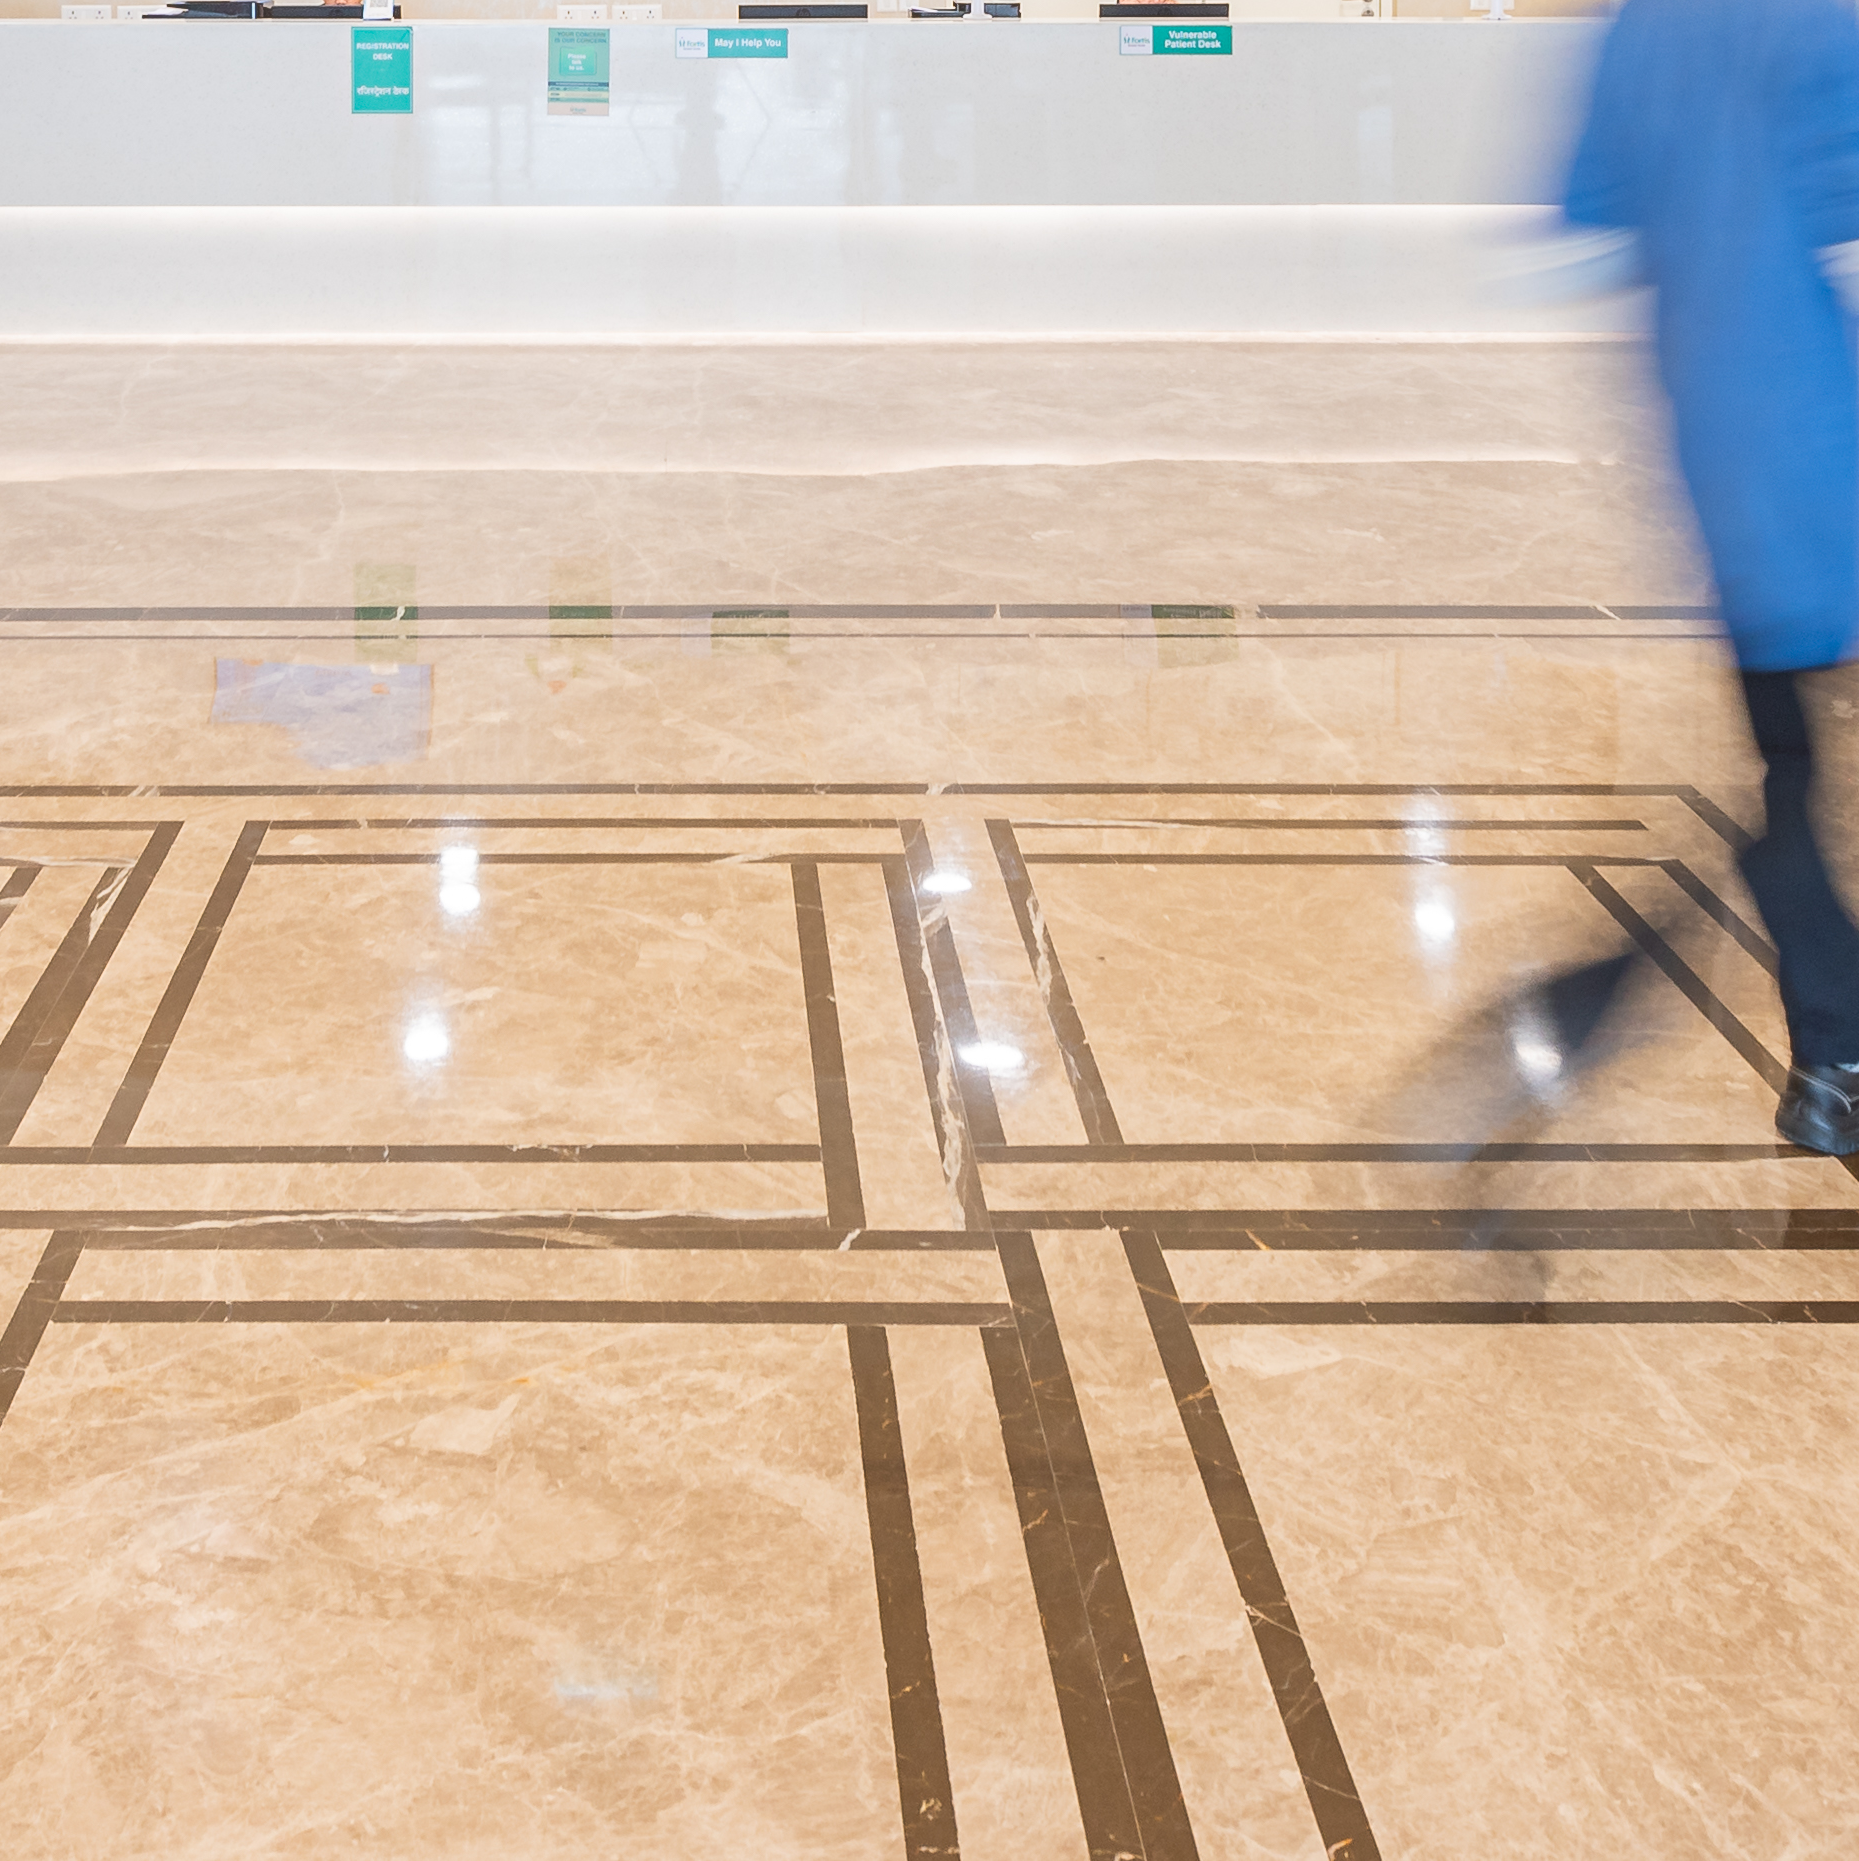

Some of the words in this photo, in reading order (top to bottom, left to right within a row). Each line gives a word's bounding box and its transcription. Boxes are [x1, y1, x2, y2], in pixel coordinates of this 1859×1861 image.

[1169, 31, 1217, 39] Vulnerable
[714, 39, 734, 49] May
[741, 39, 763, 48] Help
[765, 39, 782, 47] You
[1164, 40, 1196, 48] Patient
[1198, 40, 1221, 48] Desk
